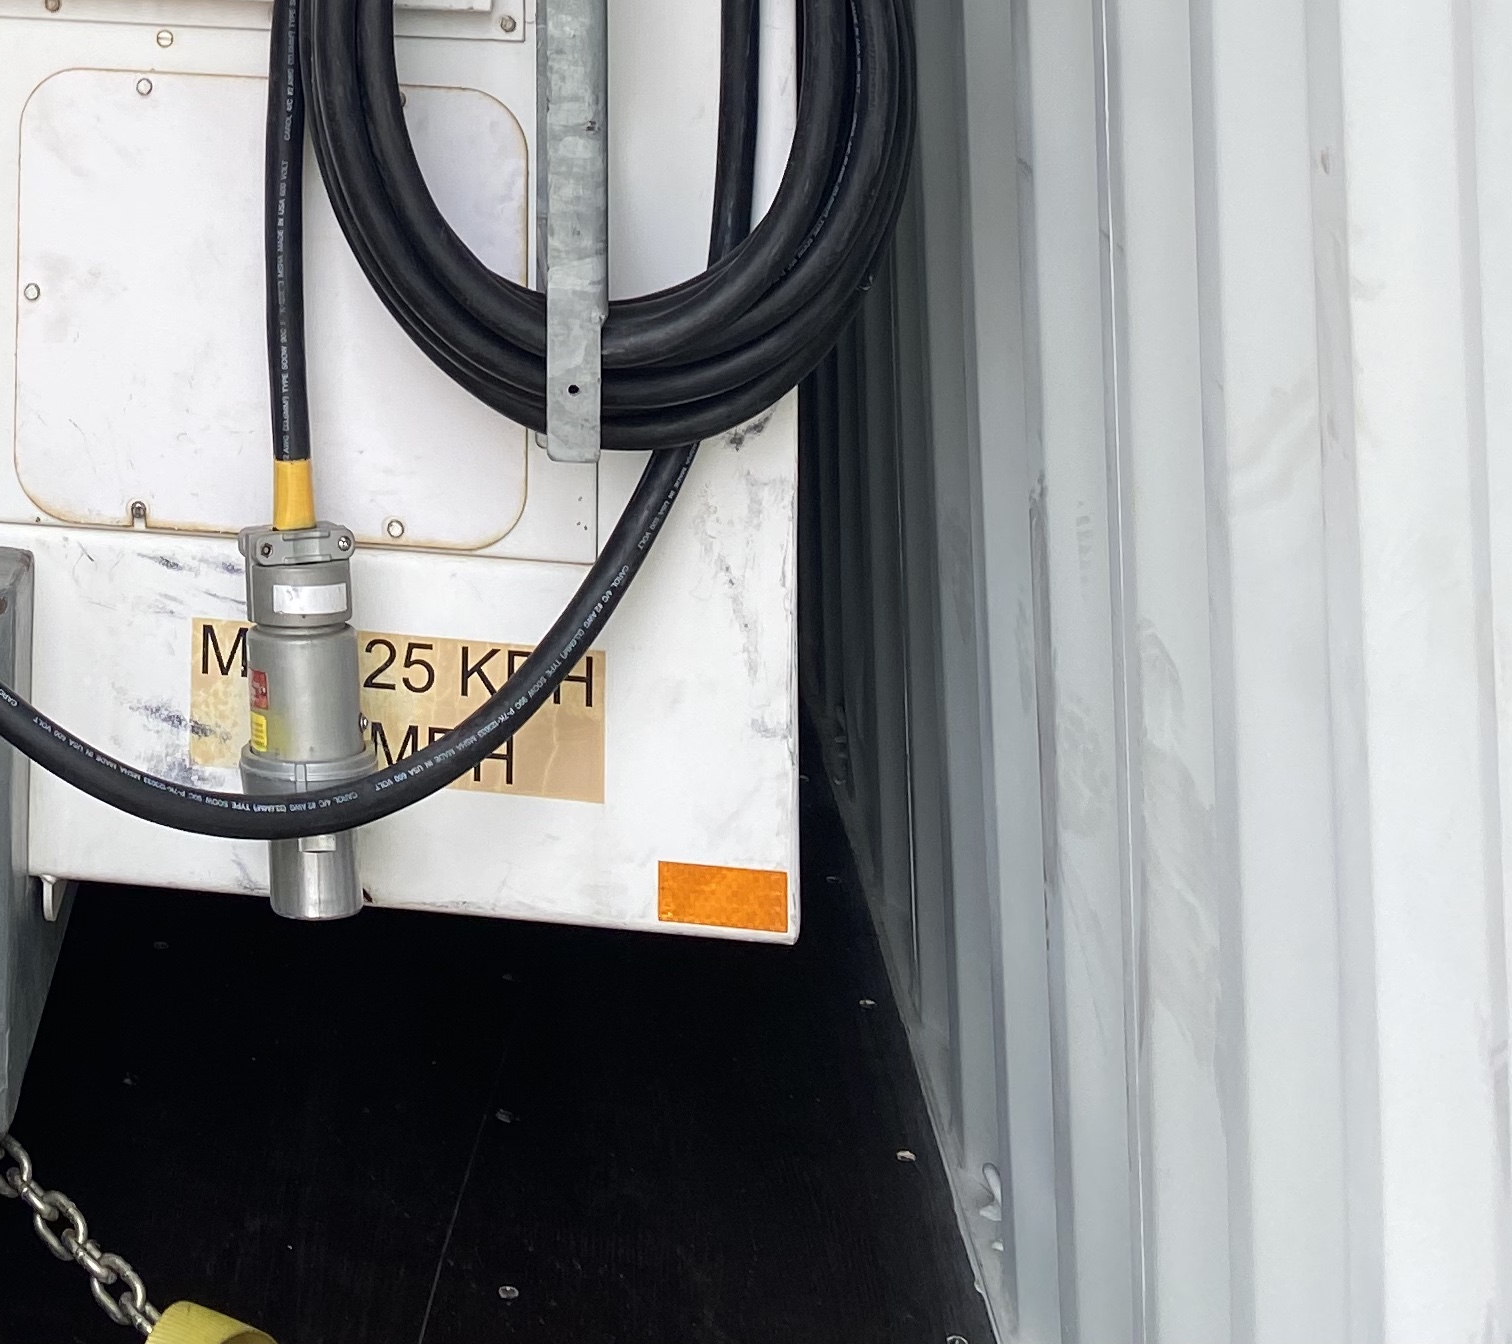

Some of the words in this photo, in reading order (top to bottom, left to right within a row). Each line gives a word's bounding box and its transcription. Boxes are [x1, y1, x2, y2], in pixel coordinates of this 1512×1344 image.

[280, 159, 289, 181] VOLT
[277, 198, 286, 216] USA
[277, 217, 285, 227] IN
[276, 229, 285, 252] MADE
[281, 345, 289, 370] SOOW
[281, 372, 289, 393] TYPE
[610, 565, 630, 588] CAROL
[363, 637, 435, 693] 25
[545, 659, 563, 678] TYPE
[33, 716, 52, 733] VOLT
[68, 738, 84, 752] USA
[407, 765, 425, 778] USA
[423, 758, 434, 770] IN
[374, 779, 394, 792] VOLT
[205, 796, 229, 808] SOOW
[231, 800, 251, 812] TYPE
[332, 791, 359, 804] CAROL
